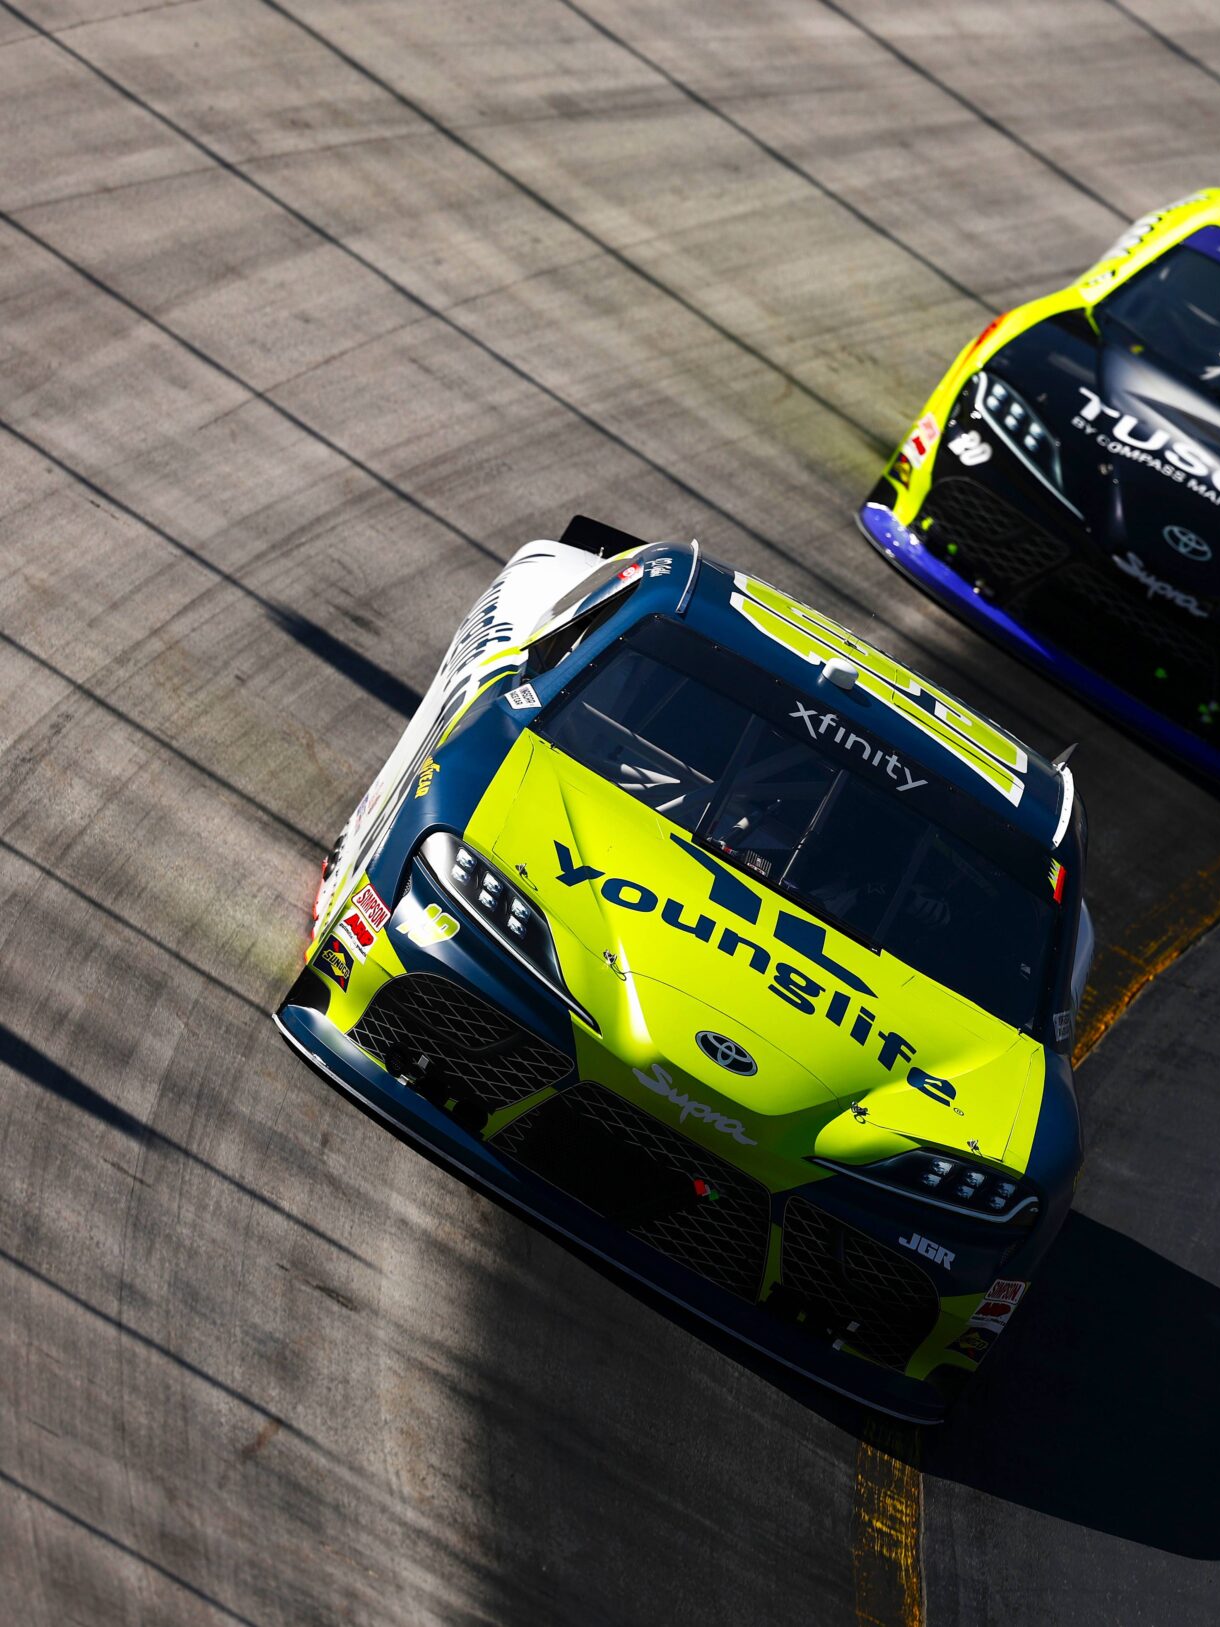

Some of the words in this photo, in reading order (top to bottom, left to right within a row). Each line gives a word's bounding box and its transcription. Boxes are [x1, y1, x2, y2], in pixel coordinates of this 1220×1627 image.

[1071, 415, 1098, 435] BY
[1096, 433, 1187, 484] COMPASS
[1111, 550, 1210, 619] Supra
[788, 700, 929, 792] xfinity
[343, 912, 375, 947] ARP
[357, 888, 388, 928] SIMPSON
[323, 950, 349, 979] SUNOCO
[554, 840, 958, 1108] younglife
[632, 1063, 759, 1147] Supra
[898, 1232, 957, 1271] JGR
